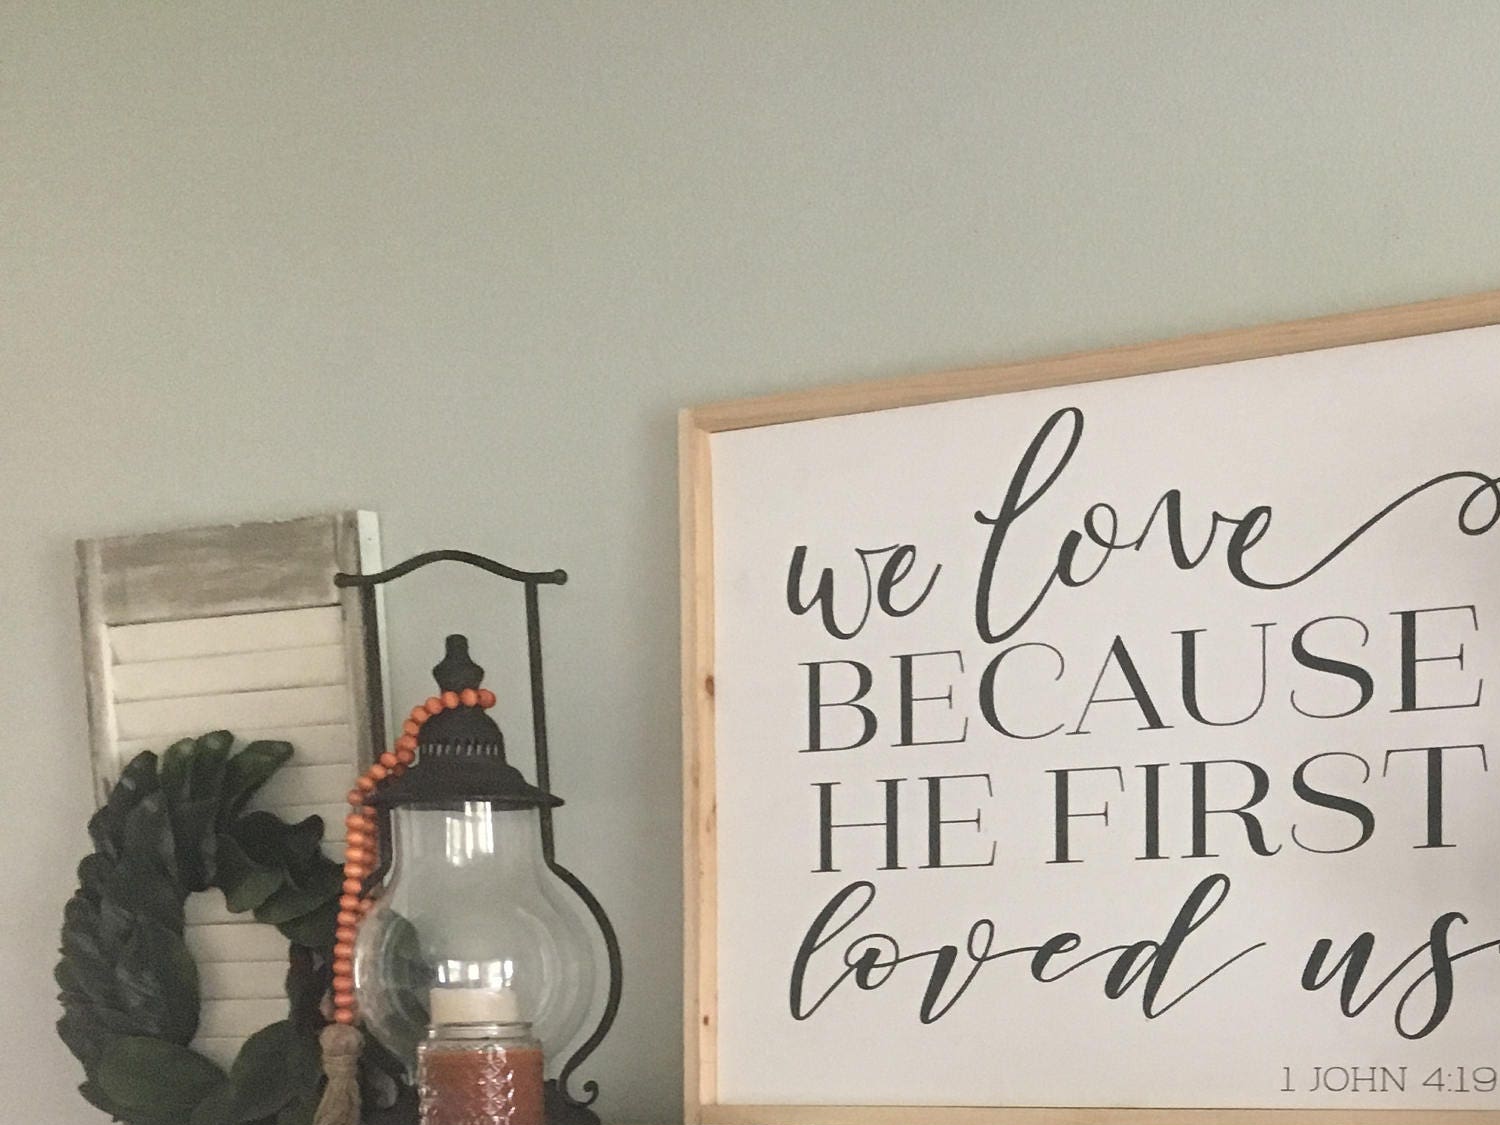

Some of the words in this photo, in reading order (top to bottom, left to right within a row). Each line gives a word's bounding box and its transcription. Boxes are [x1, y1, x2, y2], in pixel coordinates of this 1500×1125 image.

[786, 544, 942, 641] we
[798, 604, 1484, 754] BECAUSE
[810, 773, 997, 873] HE
[1045, 743, 1488, 864] FIRST
[789, 873, 1267, 1026] loved
[1280, 1065, 1297, 1092] 1
[1309, 1065, 1408, 1093] JOHN
[1421, 1065, 1498, 1093] 4:19
